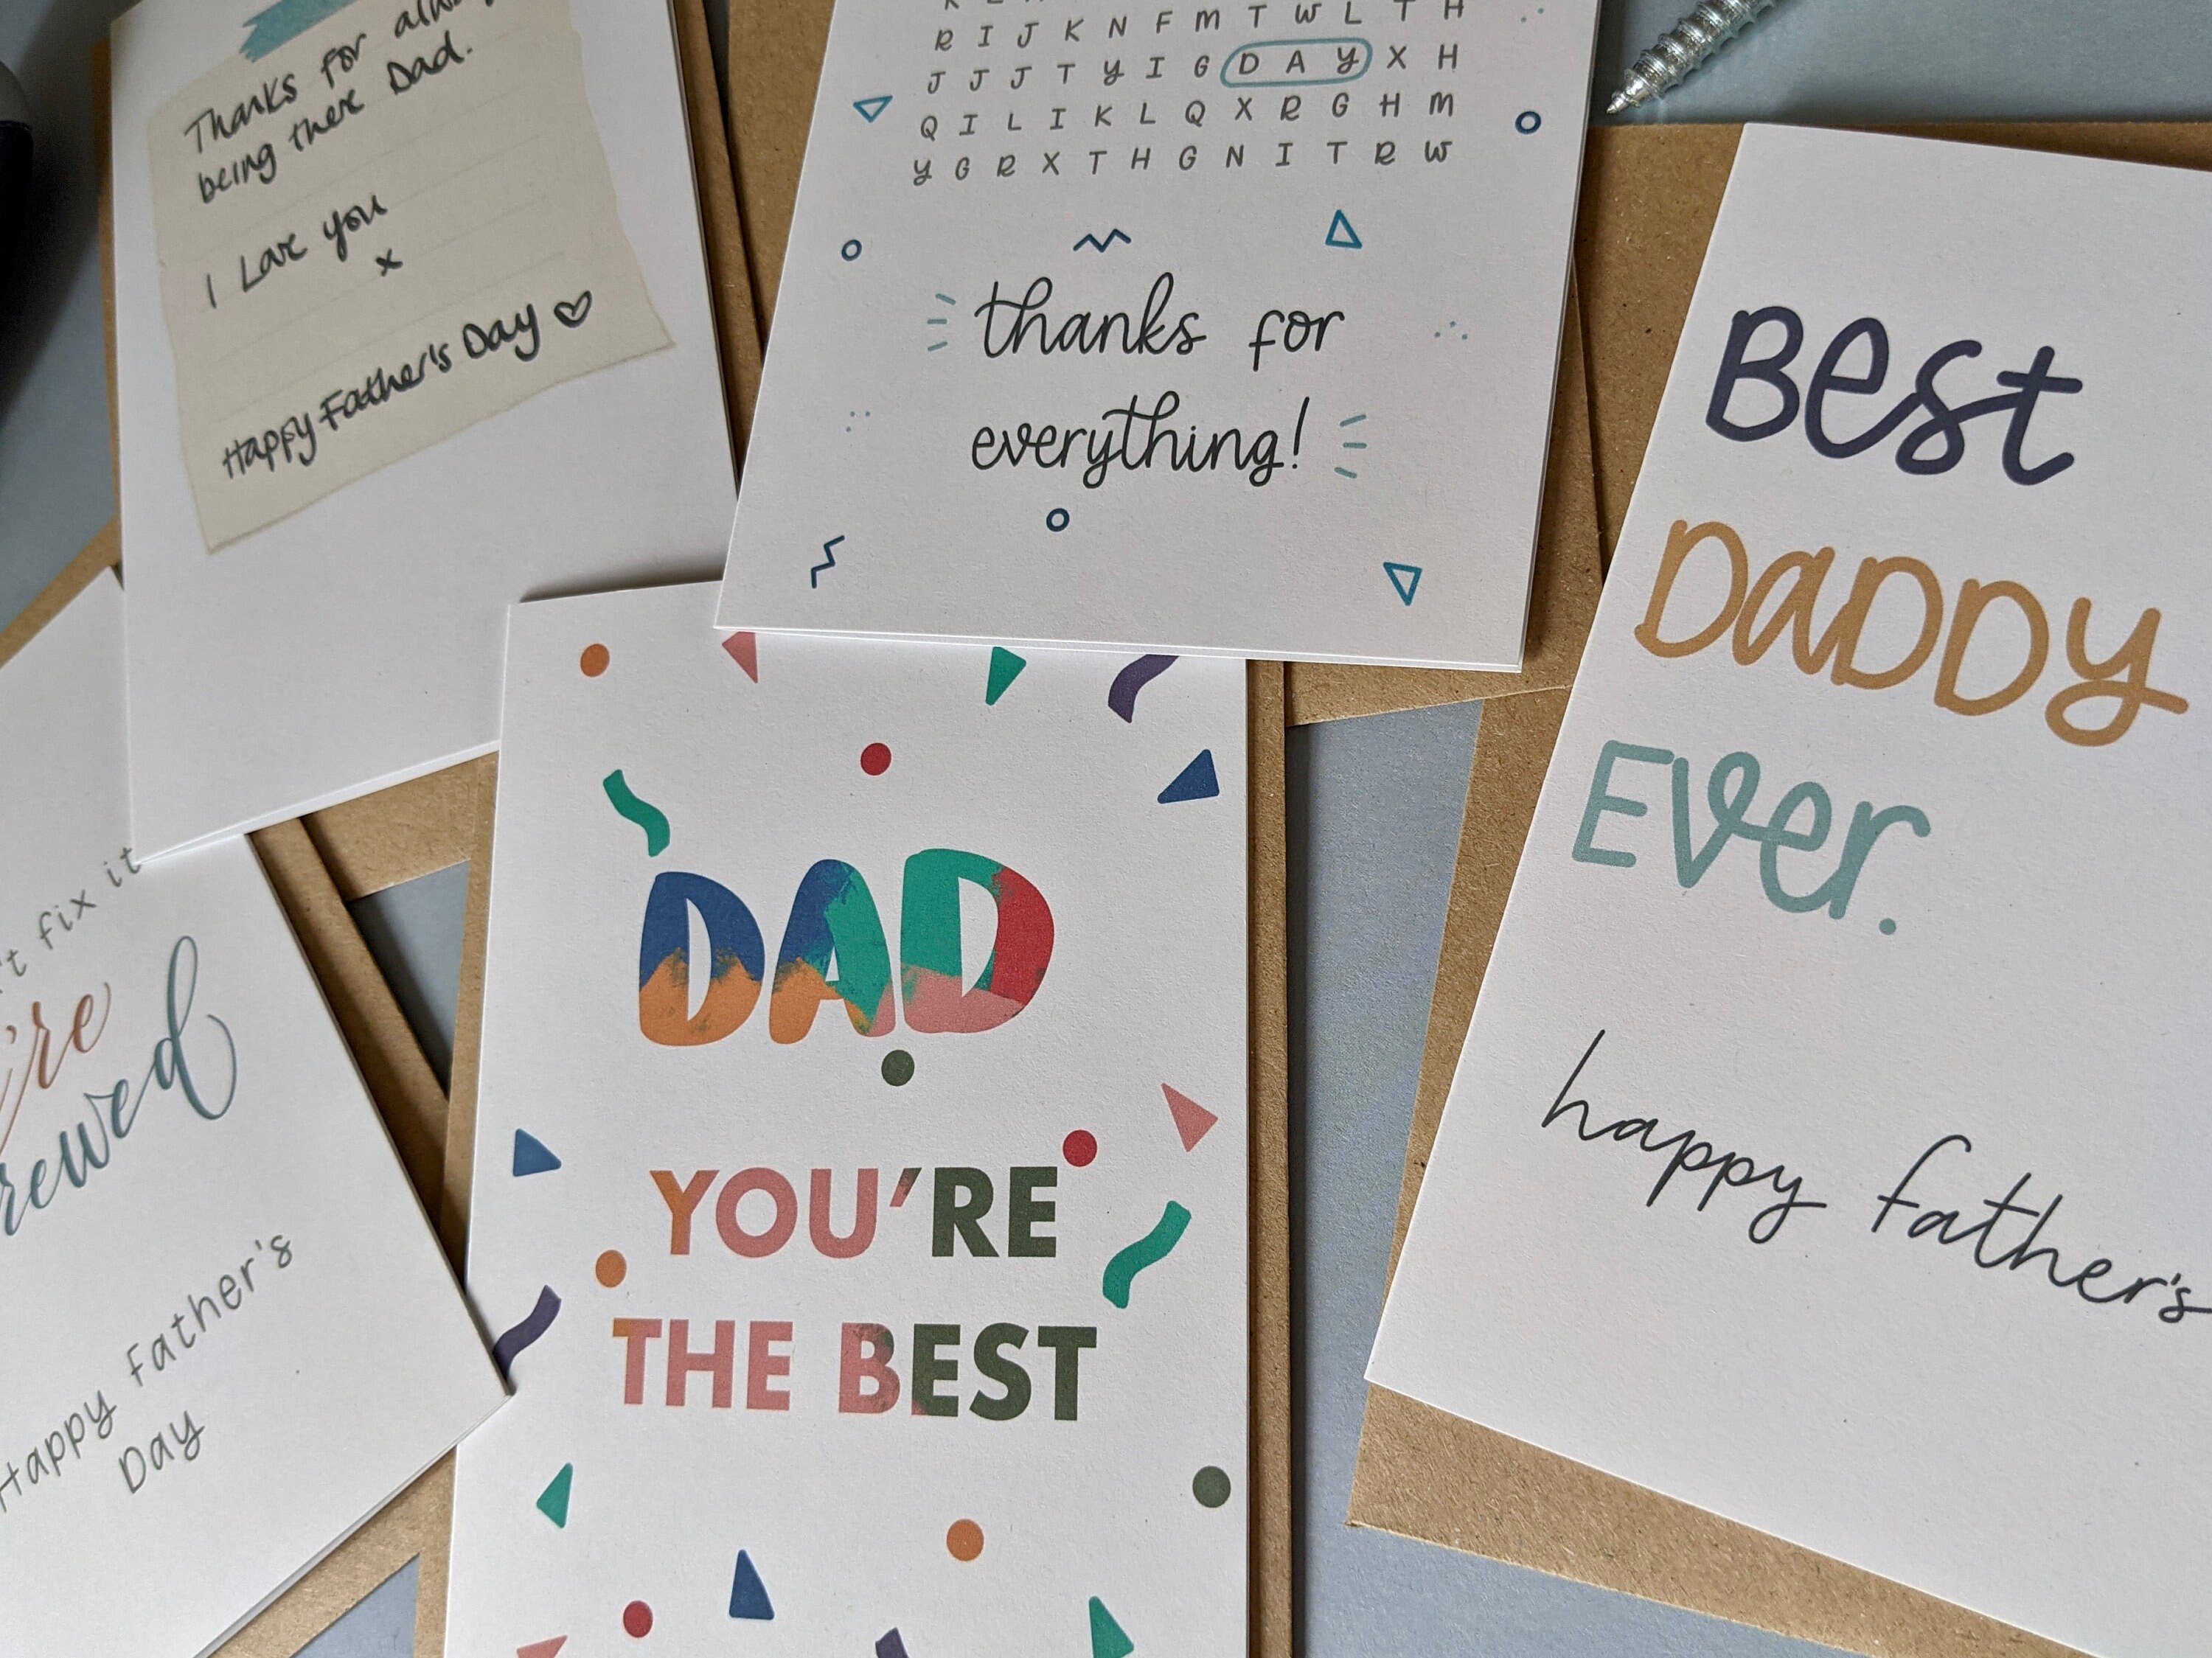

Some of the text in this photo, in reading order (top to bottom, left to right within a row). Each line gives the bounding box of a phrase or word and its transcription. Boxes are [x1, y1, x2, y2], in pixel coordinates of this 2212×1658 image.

[321, 32, 367, 89] for
[199, 143, 277, 203] being
[288, 88, 365, 152] there
[324, 195, 388, 262] you
[974, 272, 1346, 372] thanks for
[223, 304, 540, 480] Happy Father's Day
[972, 391, 1310, 489] everything!
[1706, 307, 2083, 486] Best
[39, 846, 142, 951] fix it
[639, 849, 1055, 1046] DAD
[649, 1166, 1058, 1258] YOU'RE
[1542, 1029, 2212, 1323] happy father's
[612, 1318, 1097, 1421] THE BEST
[0, 1390, 117, 1514] Happy
[119, 1410, 205, 1494] Day
